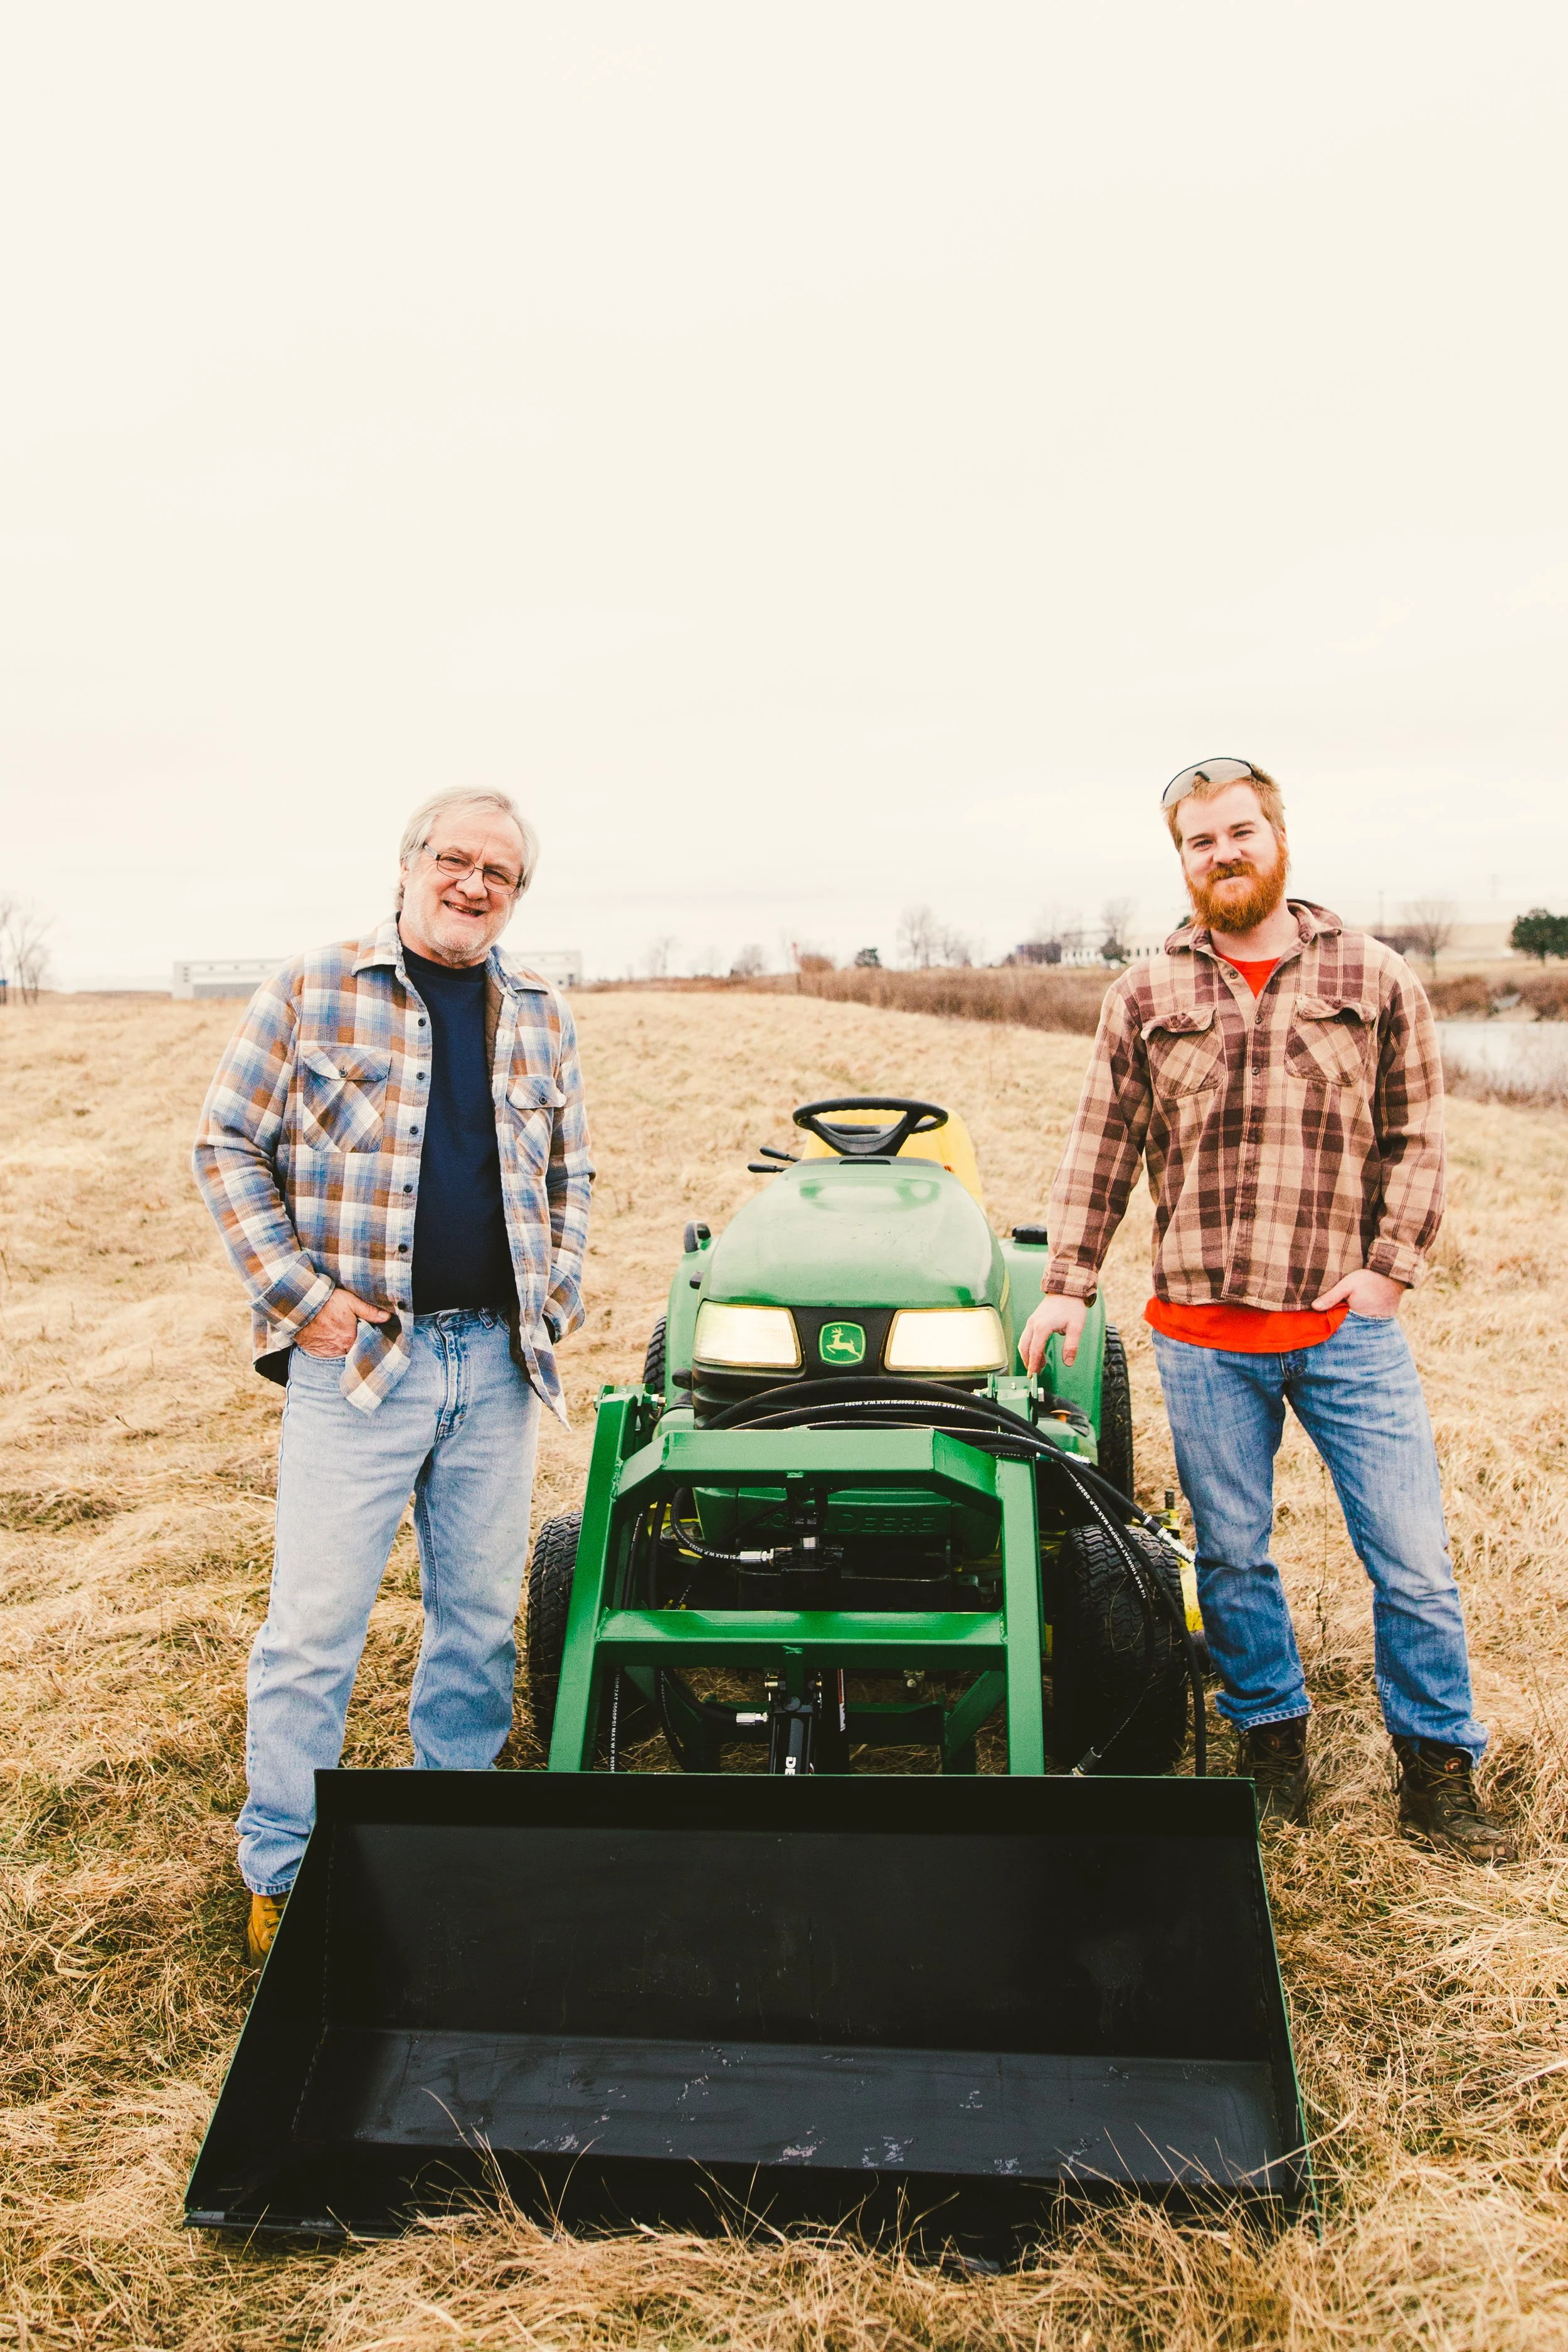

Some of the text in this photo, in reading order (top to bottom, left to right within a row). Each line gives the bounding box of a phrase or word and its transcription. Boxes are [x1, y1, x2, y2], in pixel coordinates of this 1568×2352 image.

[838, 1514, 935, 1532] DEERE
[1098, 1511, 1109, 1525] MAX
[1107, 1525, 1124, 1549] 5000PSI
[1121, 1549, 1137, 1575] 100R2AT
